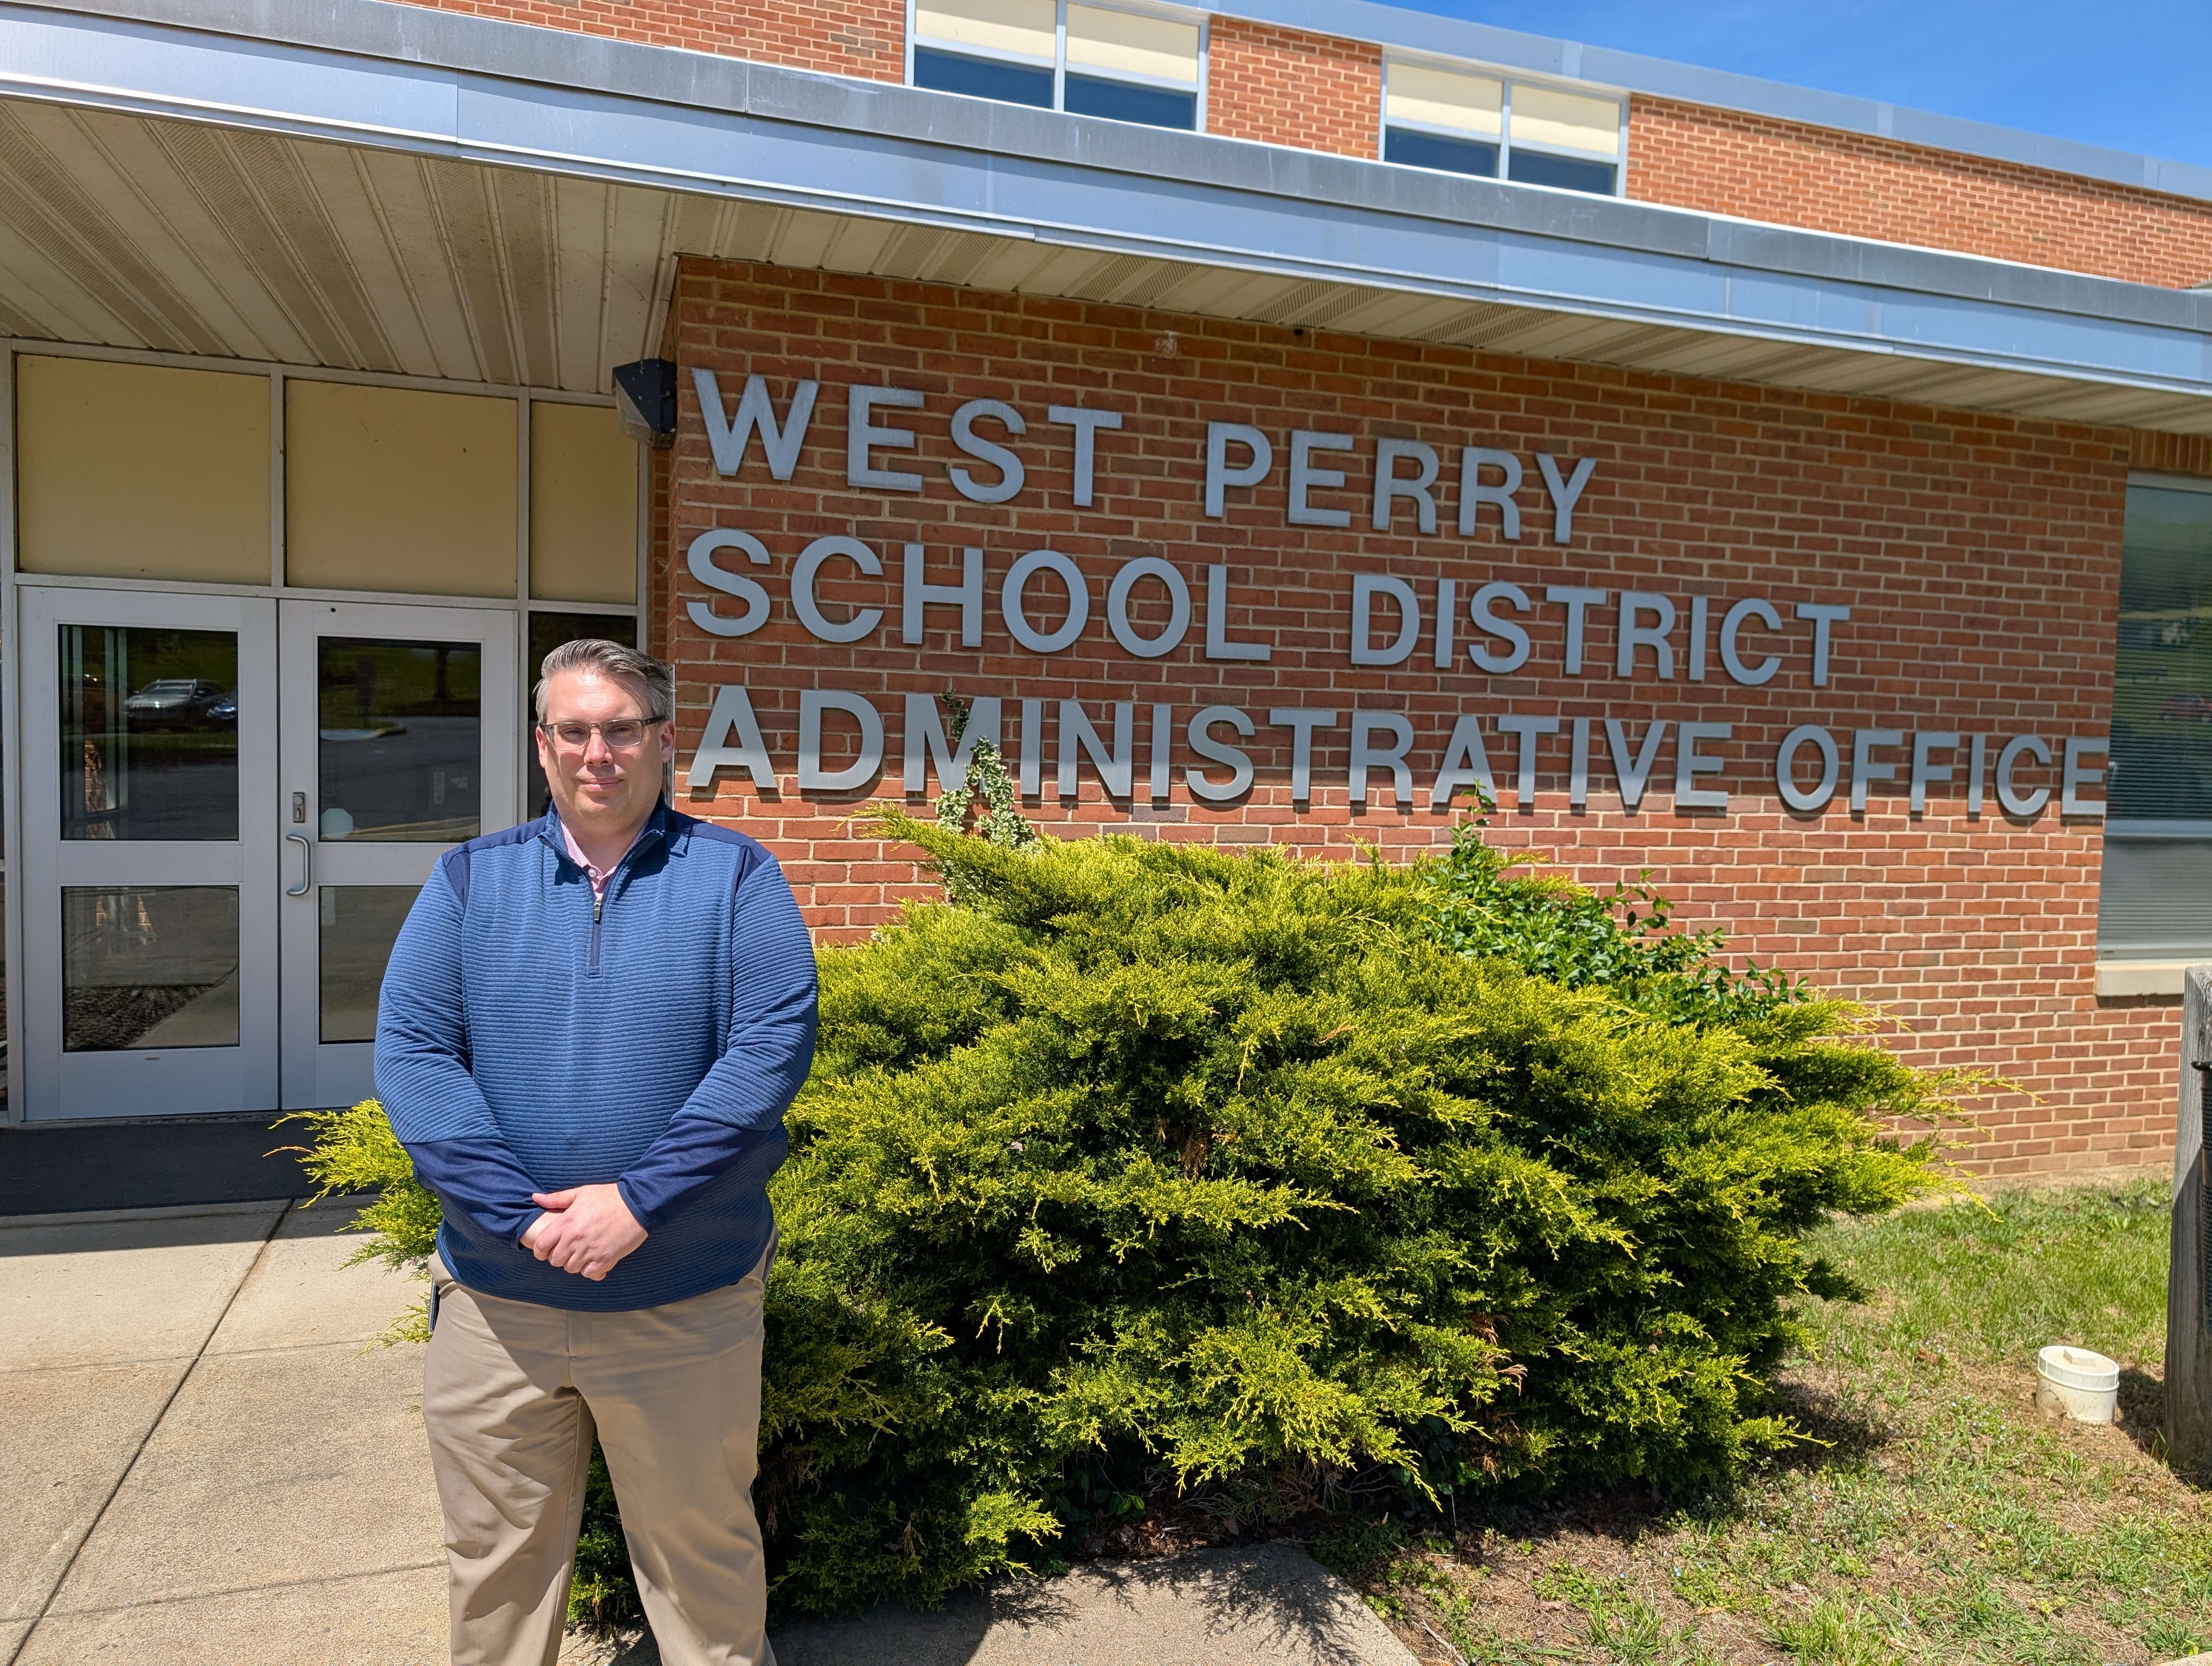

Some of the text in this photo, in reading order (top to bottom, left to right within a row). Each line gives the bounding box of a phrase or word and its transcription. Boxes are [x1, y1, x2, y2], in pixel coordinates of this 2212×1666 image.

[692, 368, 1597, 543] WEST PERRY
[686, 529, 1850, 687] SCHOOL DISTRICT
[686, 685, 2110, 817] ADMINISTRATIVE OFFICE
